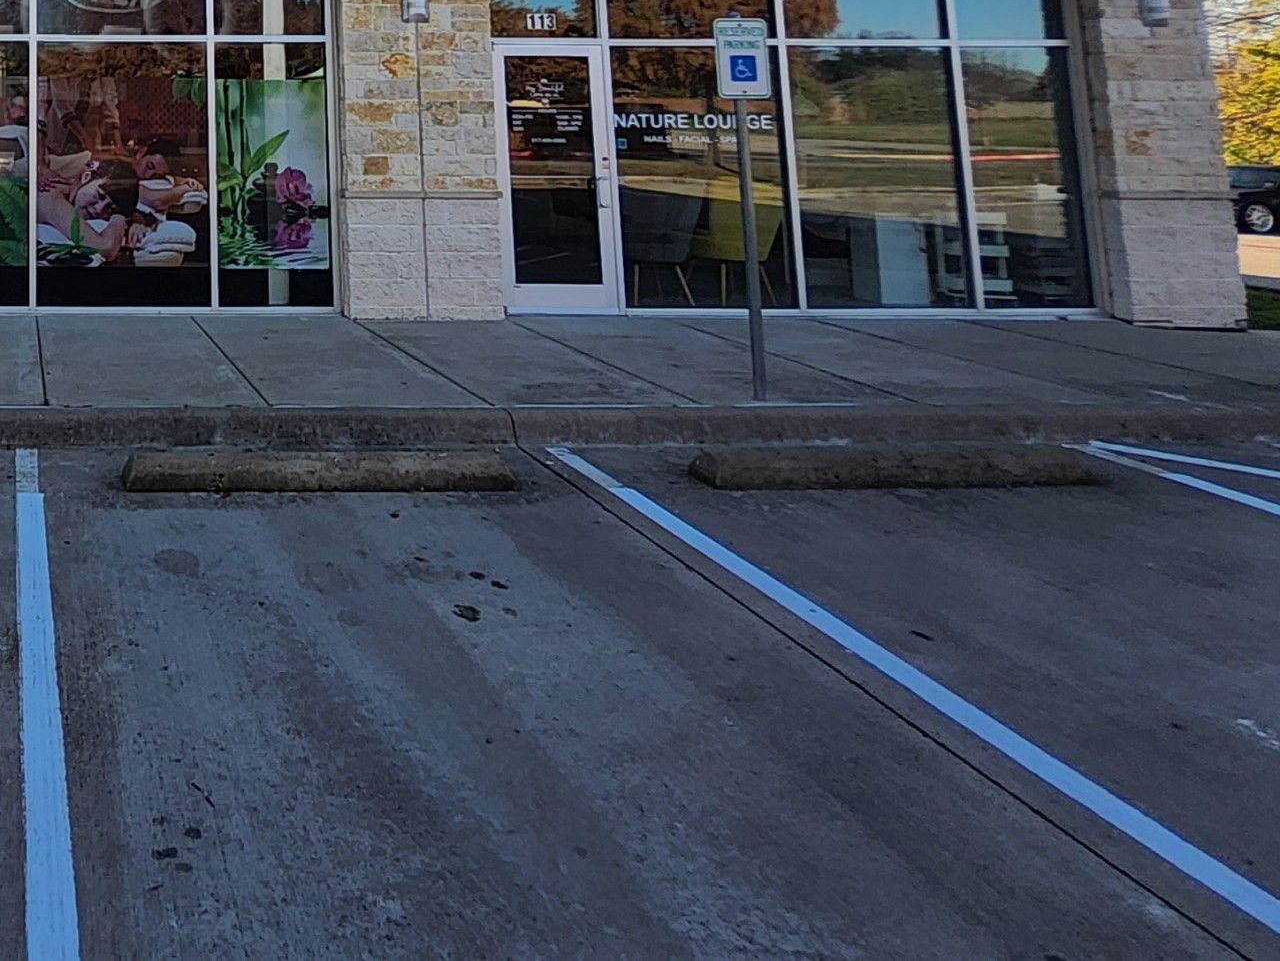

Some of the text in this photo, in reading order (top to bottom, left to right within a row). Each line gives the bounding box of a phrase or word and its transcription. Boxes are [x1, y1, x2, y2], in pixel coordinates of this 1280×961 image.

[527, 14, 556, 30] 113
[613, 113, 689, 129] NATURE
[643, 135, 671, 143] NAILS
[678, 135, 713, 144] FACIAL
